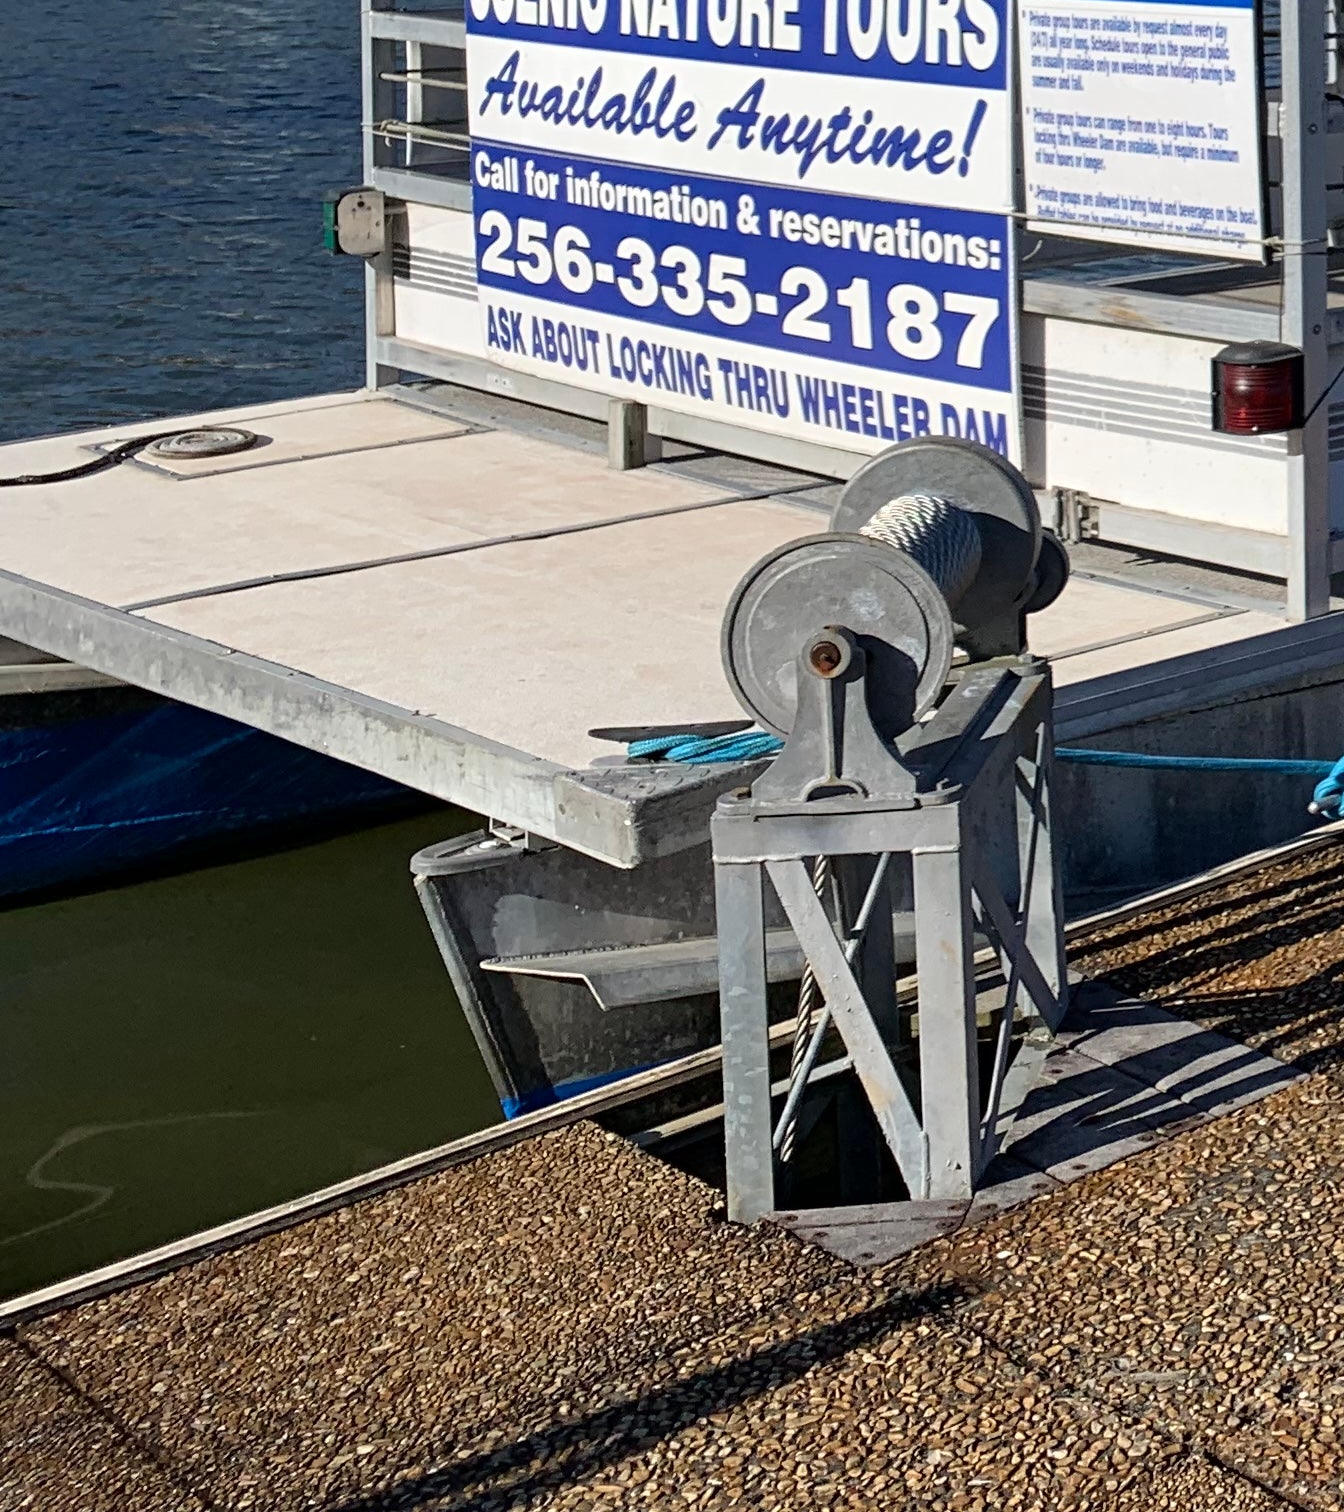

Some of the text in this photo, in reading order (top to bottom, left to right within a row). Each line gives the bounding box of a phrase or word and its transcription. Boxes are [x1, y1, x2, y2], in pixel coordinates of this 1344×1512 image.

[478, 50, 989, 179] Available Anytime!
[474, 150, 1002, 272] Call for information & reservations:
[479, 208, 1002, 371] 256-335-2187
[486, 303, 1008, 460] ASK ABOUT LOCKING THRU WHEELER DAM
